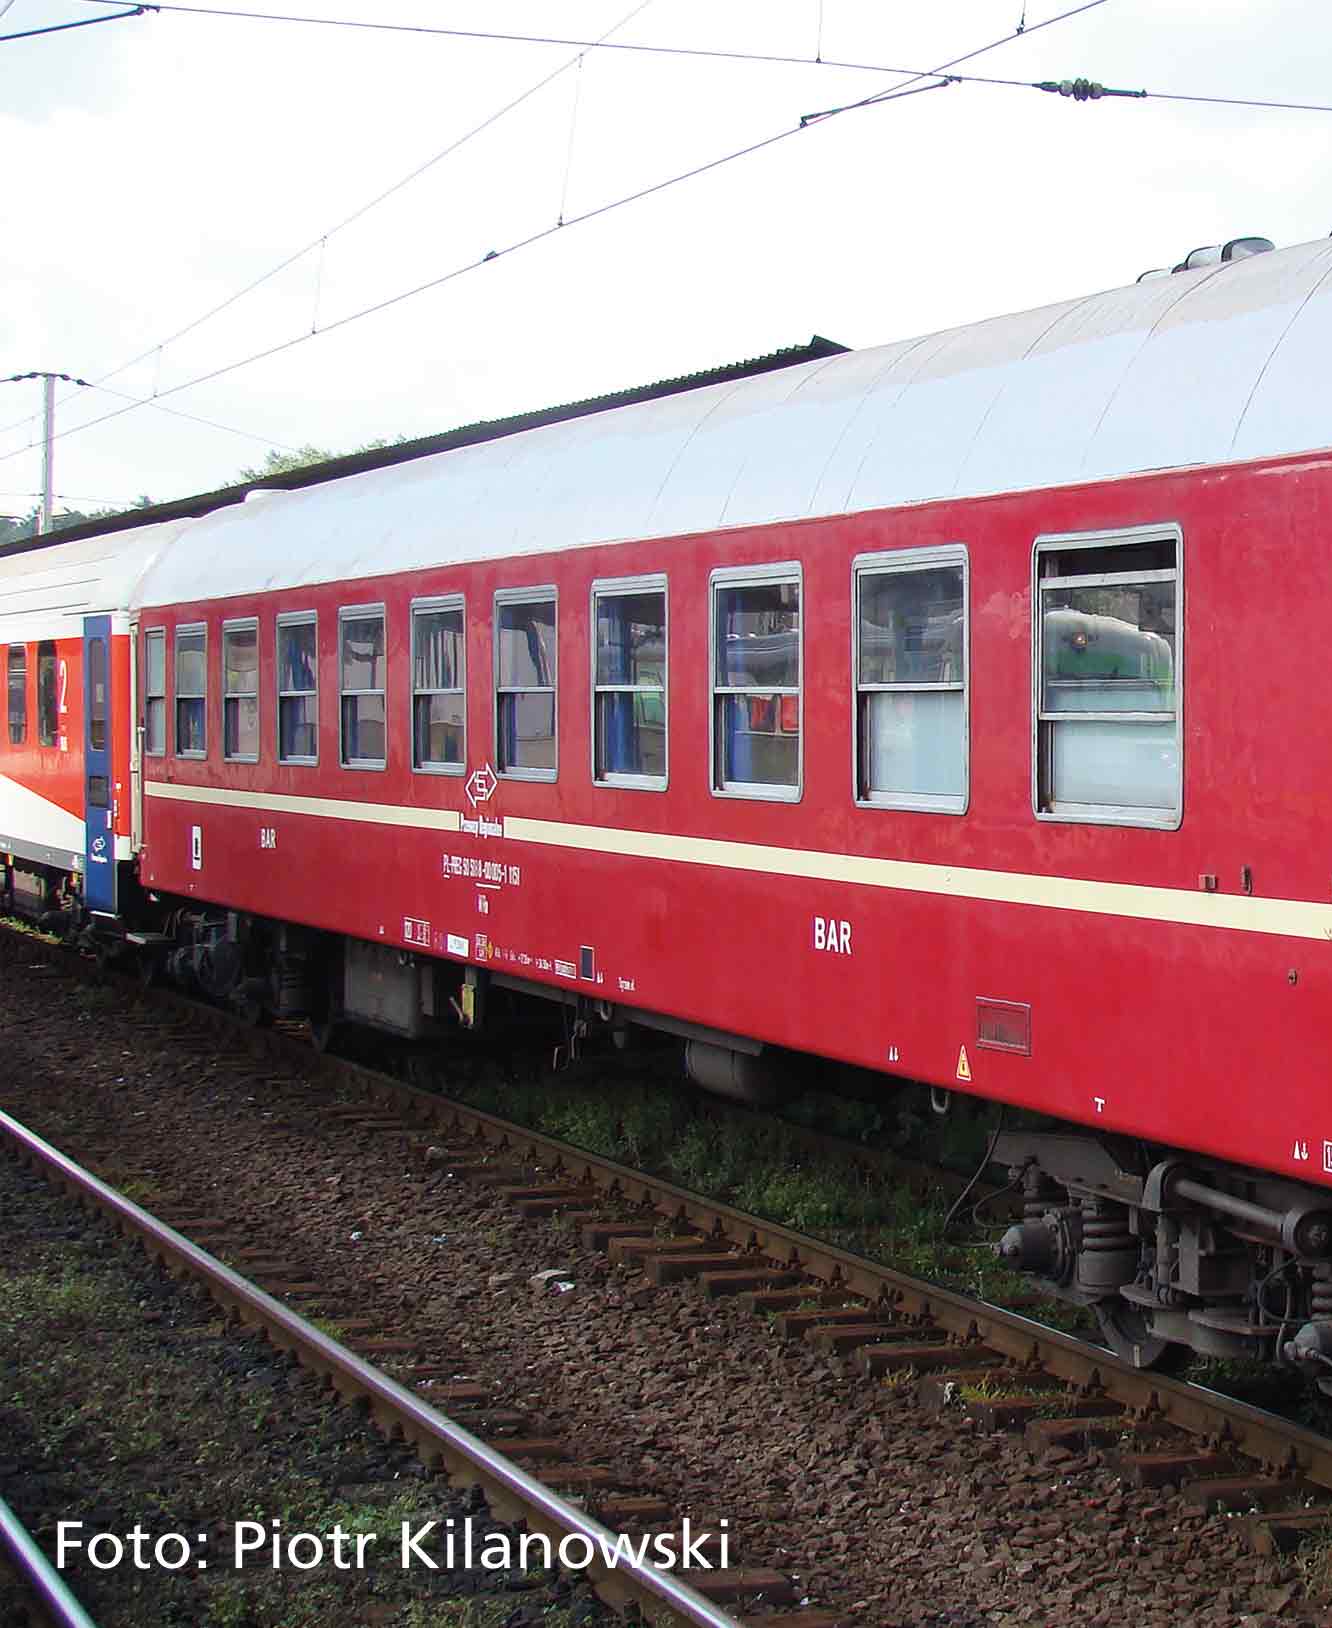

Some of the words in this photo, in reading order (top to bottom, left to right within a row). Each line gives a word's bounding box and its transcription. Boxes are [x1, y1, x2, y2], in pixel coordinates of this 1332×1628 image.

[59, 659, 69, 714] 2
[260, 827, 277, 849] BAR
[814, 916, 852, 955] BAR
